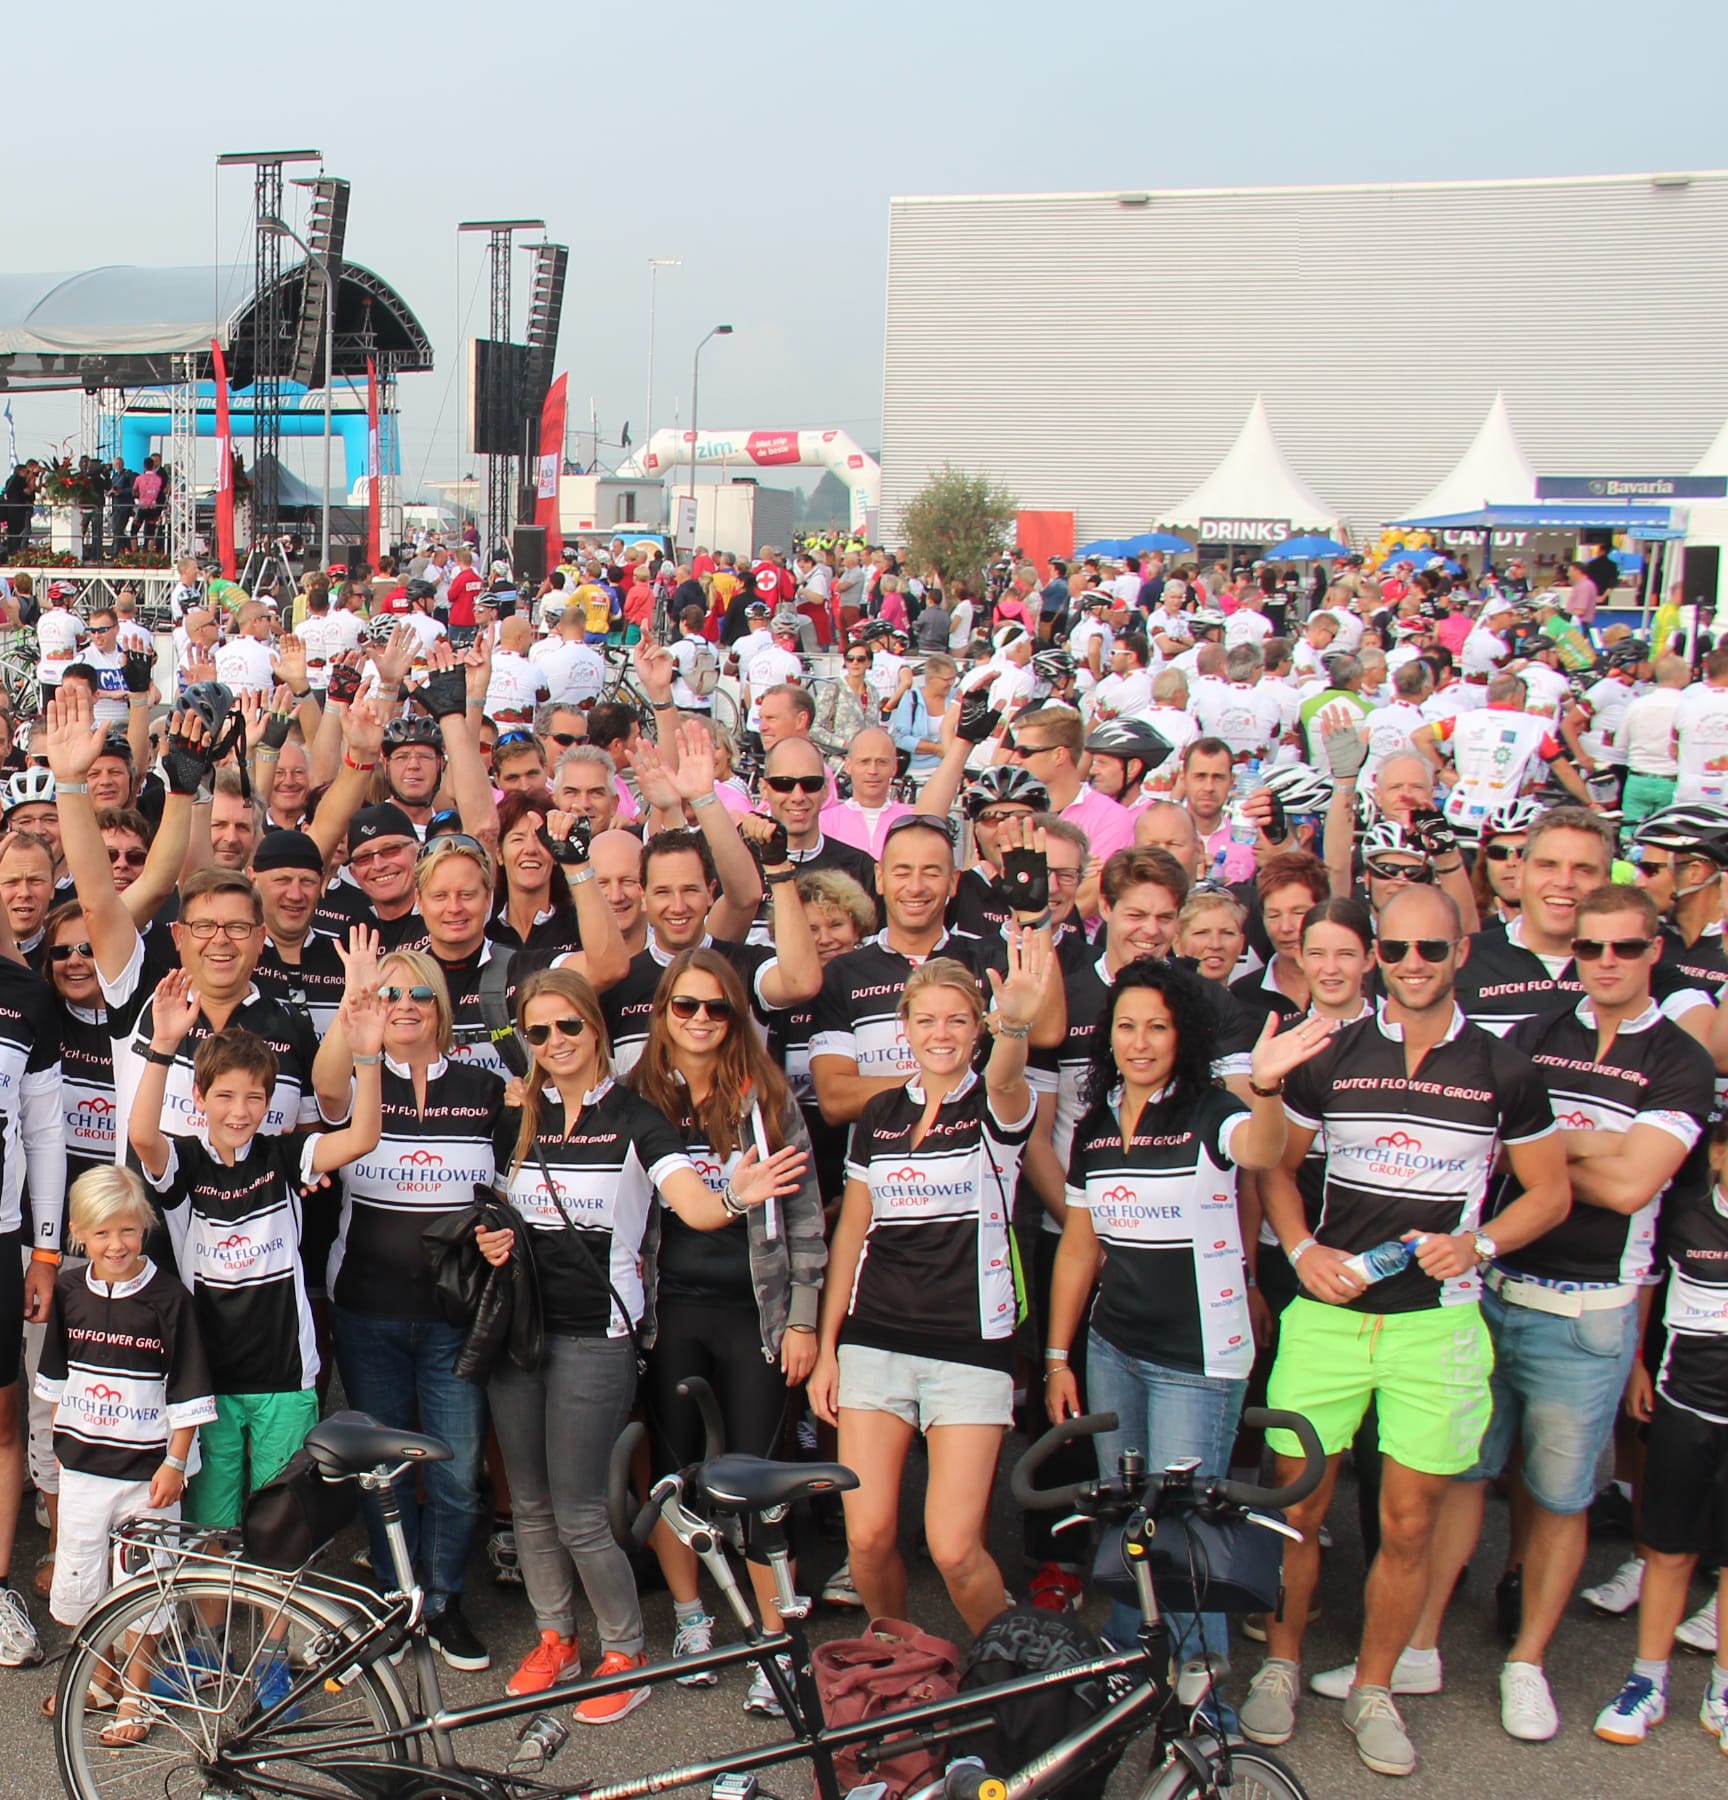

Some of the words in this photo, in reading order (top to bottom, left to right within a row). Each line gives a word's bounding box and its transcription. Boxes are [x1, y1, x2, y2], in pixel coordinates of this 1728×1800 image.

[696, 438, 739, 459] zlm.
[1606, 478, 1675, 495] Bavaria
[1201, 521, 1288, 541] DRINKS
[314, 908, 339, 921] LOWER
[851, 984, 892, 1000] DUTCH
[1479, 982, 1523, 998] DUTCH
[1069, 1025, 1096, 1037] DUT
[1332, 1078, 1378, 1091] DUTCH
[1380, 1078, 1441, 1096] FLOWER
[1443, 1085, 1493, 1102] GROUP
[1333, 1143, 1391, 1163] DUTCH
[1395, 1152, 1466, 1172] FLOWER
[354, 1163, 414, 1182] DUTCH
[420, 1167, 487, 1183] FLOWER
[1368, 1162, 1416, 1178] GROUP
[396, 1181, 442, 1193] GROUP
[909, 1181, 973, 1196] FLOWER
[508, 1192, 551, 1207] DUTCH
[890, 1196, 929, 1208] GROUP
[1091, 1204, 1119, 1218] TCH
[1121, 1204, 1182, 1219] FLOWER
[41, 1222, 54, 1237] FJ
[1107, 1217, 1140, 1229] GROUP
[236, 1237, 284, 1259] FLOWER
[1686, 1249, 1721, 1259] DUTCH
[67, 1327, 84, 1341] TCH
[84, 1329, 133, 1347] FLOWER
[135, 1335, 161, 1350] GRO
[99, 1404, 160, 1421] FLOWER
[1044, 1664, 1088, 1682] COLLECTIVE
